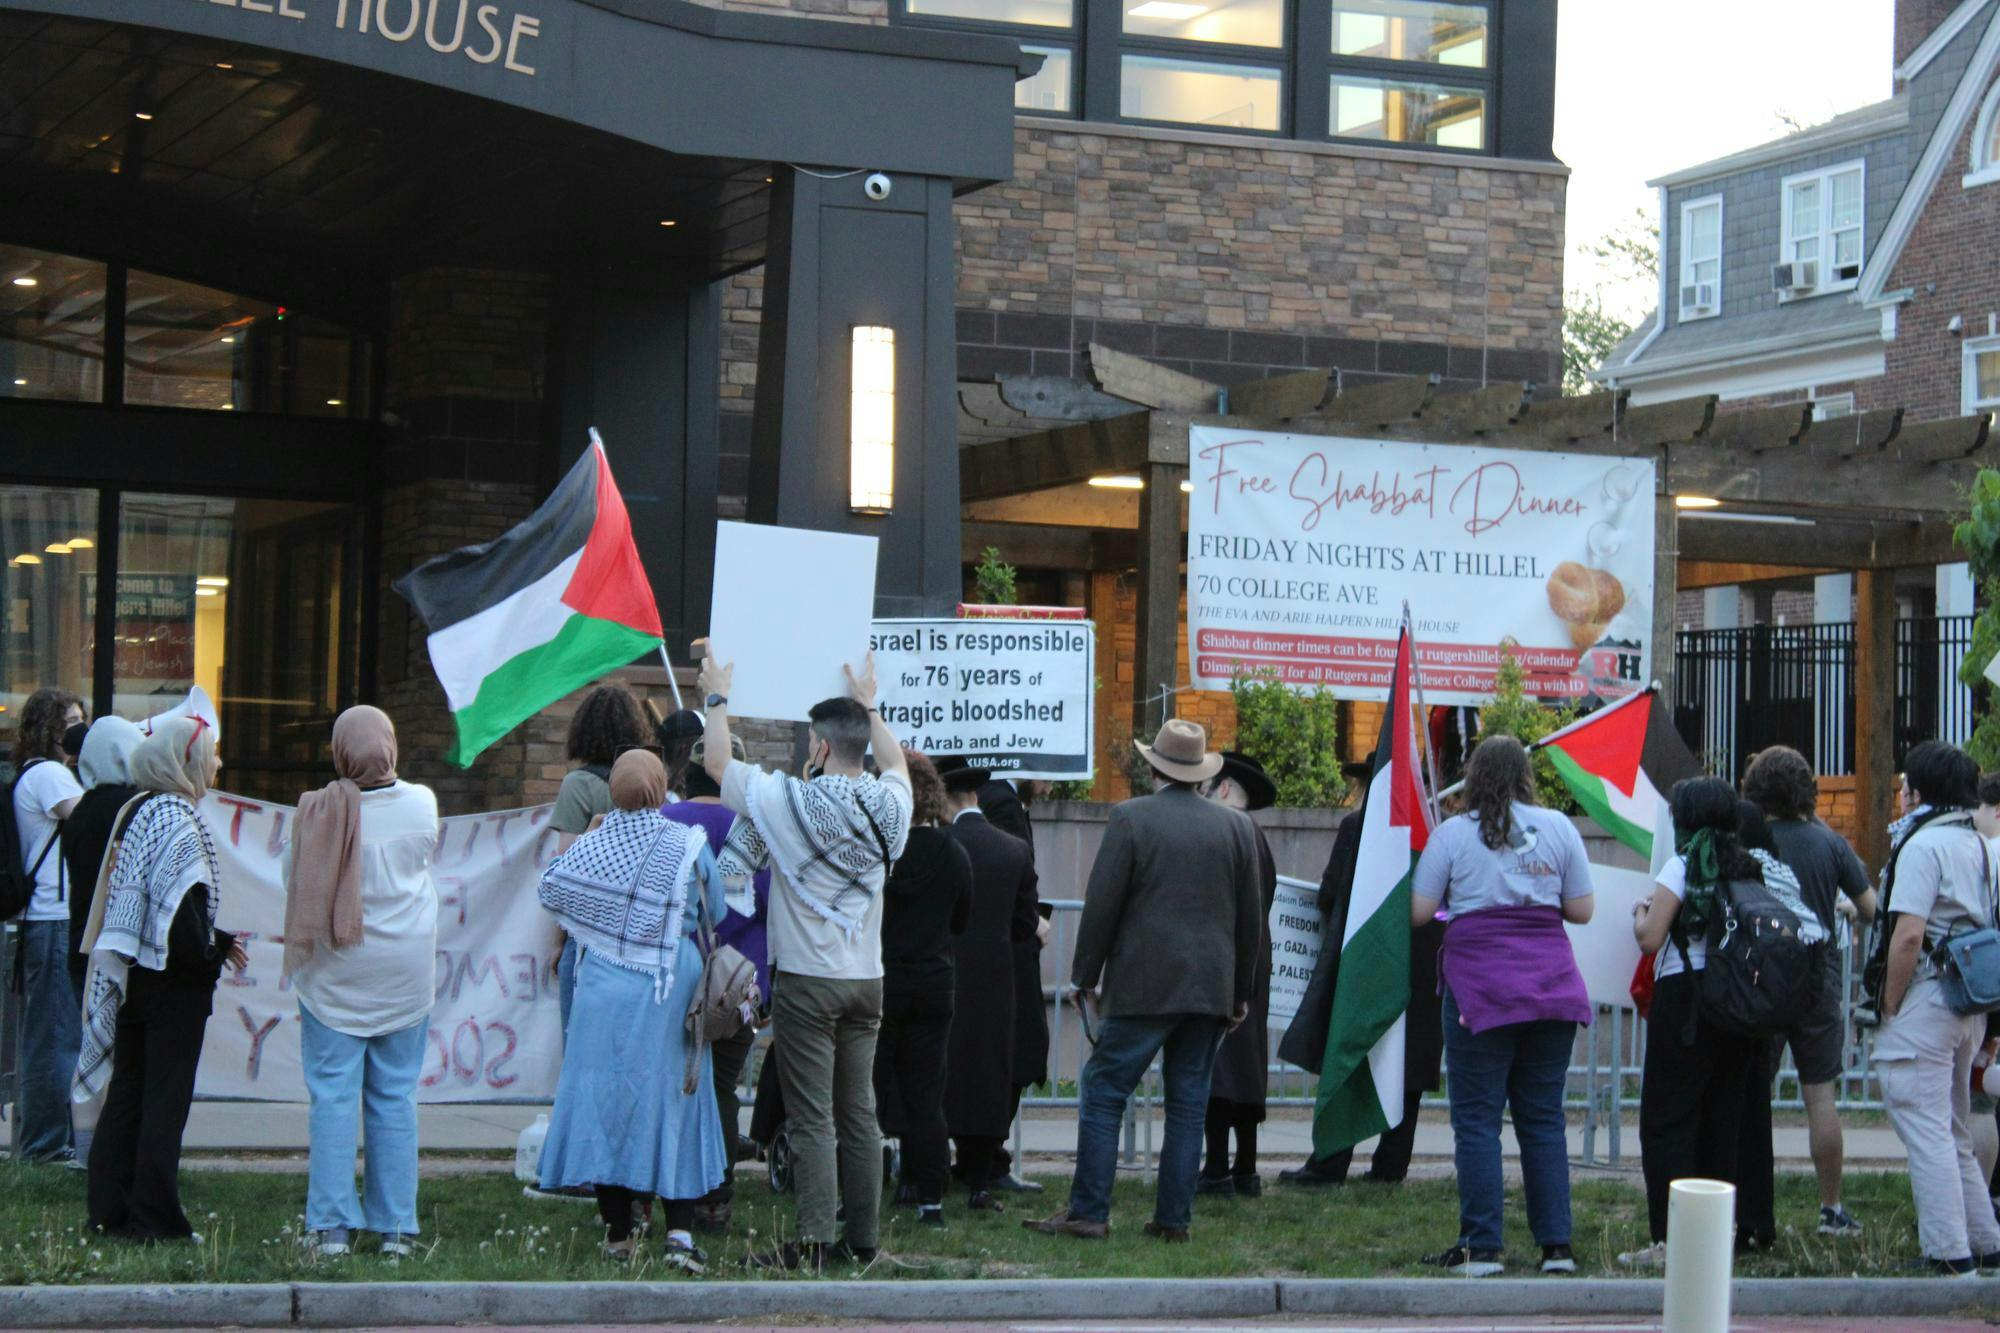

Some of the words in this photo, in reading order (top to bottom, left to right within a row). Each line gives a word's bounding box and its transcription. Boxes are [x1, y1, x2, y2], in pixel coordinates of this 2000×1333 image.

[1199, 440, 1277, 515] Free
[1289, 452, 1451, 531] Shabbat
[1449, 461, 1588, 539] Dinner
[1199, 534, 1298, 563] FRIDAY
[1306, 542, 1405, 571] NIGHTS
[1412, 549, 1446, 573] AT
[1455, 552, 1544, 579] HILLEL
[1198, 574, 1221, 595] 70
[1227, 577, 1329, 603] COLLEGE
[1336, 585, 1378, 605] AVE
[1198, 606, 1221, 619] THE
[1225, 608, 1249, 620] EVA
[1251, 609, 1280, 622] AND
[1282, 612, 1312, 624] ARIE
[1314, 614, 1372, 628] HALPERN
[1418, 619, 1461, 633] HOUSE
[869, 629, 921, 652] srael
[929, 629, 948, 651] is
[955, 630, 1084, 656] responsible
[1202, 633, 1250, 649] Shabbat
[1252, 637, 1294, 654] dinner
[1297, 640, 1331, 655] times
[1333, 645, 1355, 657] can
[1357, 643, 1372, 657] be
[901, 672, 921, 687] for
[924, 665, 949, 687] 76
[960, 665, 1021, 692] years
[1028, 671, 1043, 686] of
[1287, 664, 1306, 679] for
[1308, 667, 1322, 680] all
[1325, 669, 1368, 684] Rutgers
[1370, 670, 1394, 684] and
[1453, 674, 1495, 691] College
[1543, 679, 1567, 693] with
[1569, 679, 1584, 692] ID
[1591, 652, 1641, 680] RH
[879, 700, 944, 729] tragic
[952, 699, 1064, 723] bloodshed
[900, 735, 918, 751] of
[922, 735, 963, 750] Arab
[969, 733, 1000, 749] and
[1006, 733, 1044, 749] Jew
[1279, 913, 1320, 934] FREEDOM
[1284, 940, 1308, 957] GAZA
